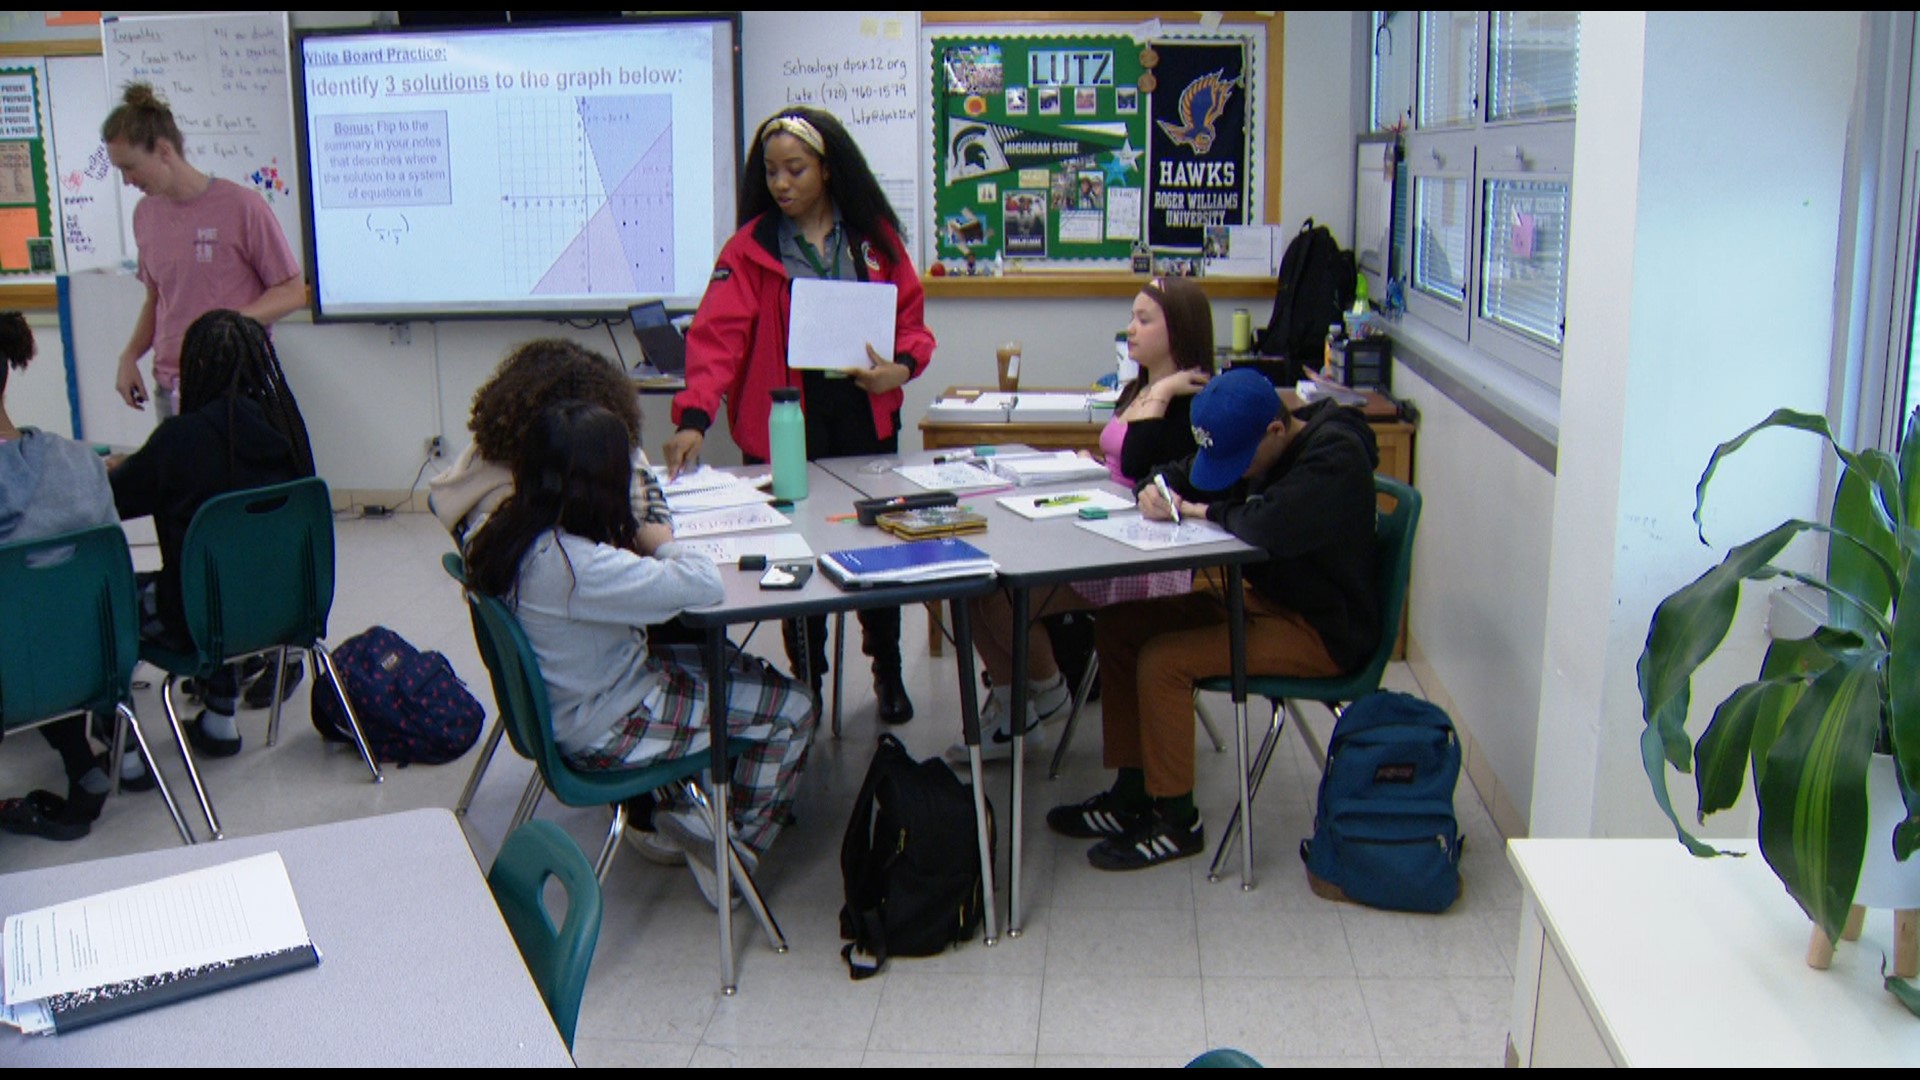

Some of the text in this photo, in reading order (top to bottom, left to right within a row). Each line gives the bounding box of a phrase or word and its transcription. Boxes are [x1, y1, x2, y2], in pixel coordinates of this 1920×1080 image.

[342, 48, 383, 63] Board
[386, 47, 448, 61] Practice:
[783, 57, 839, 79] Schoology
[1032, 55, 1111, 85] LUTZ
[311, 66, 682, 98] Identify 3 solutions to the graph below:
[334, 120, 429, 135] Bonus: Flip to the
[324, 136, 441, 152] summary in your notes
[1003, 142, 1079, 155] MICHIGAN STATE
[330, 152, 437, 168] that describes where
[343, 171, 383, 183] solution
[386, 170, 396, 182] to
[409, 170, 446, 183] system
[1159, 160, 1236, 188] HAWKS
[349, 186, 423, 200] of equations is
[1154, 191, 1185, 209] ROGER
[1188, 191, 1239, 210] WILLIAMS
[1165, 209, 1226, 228] UNIVERSITY
